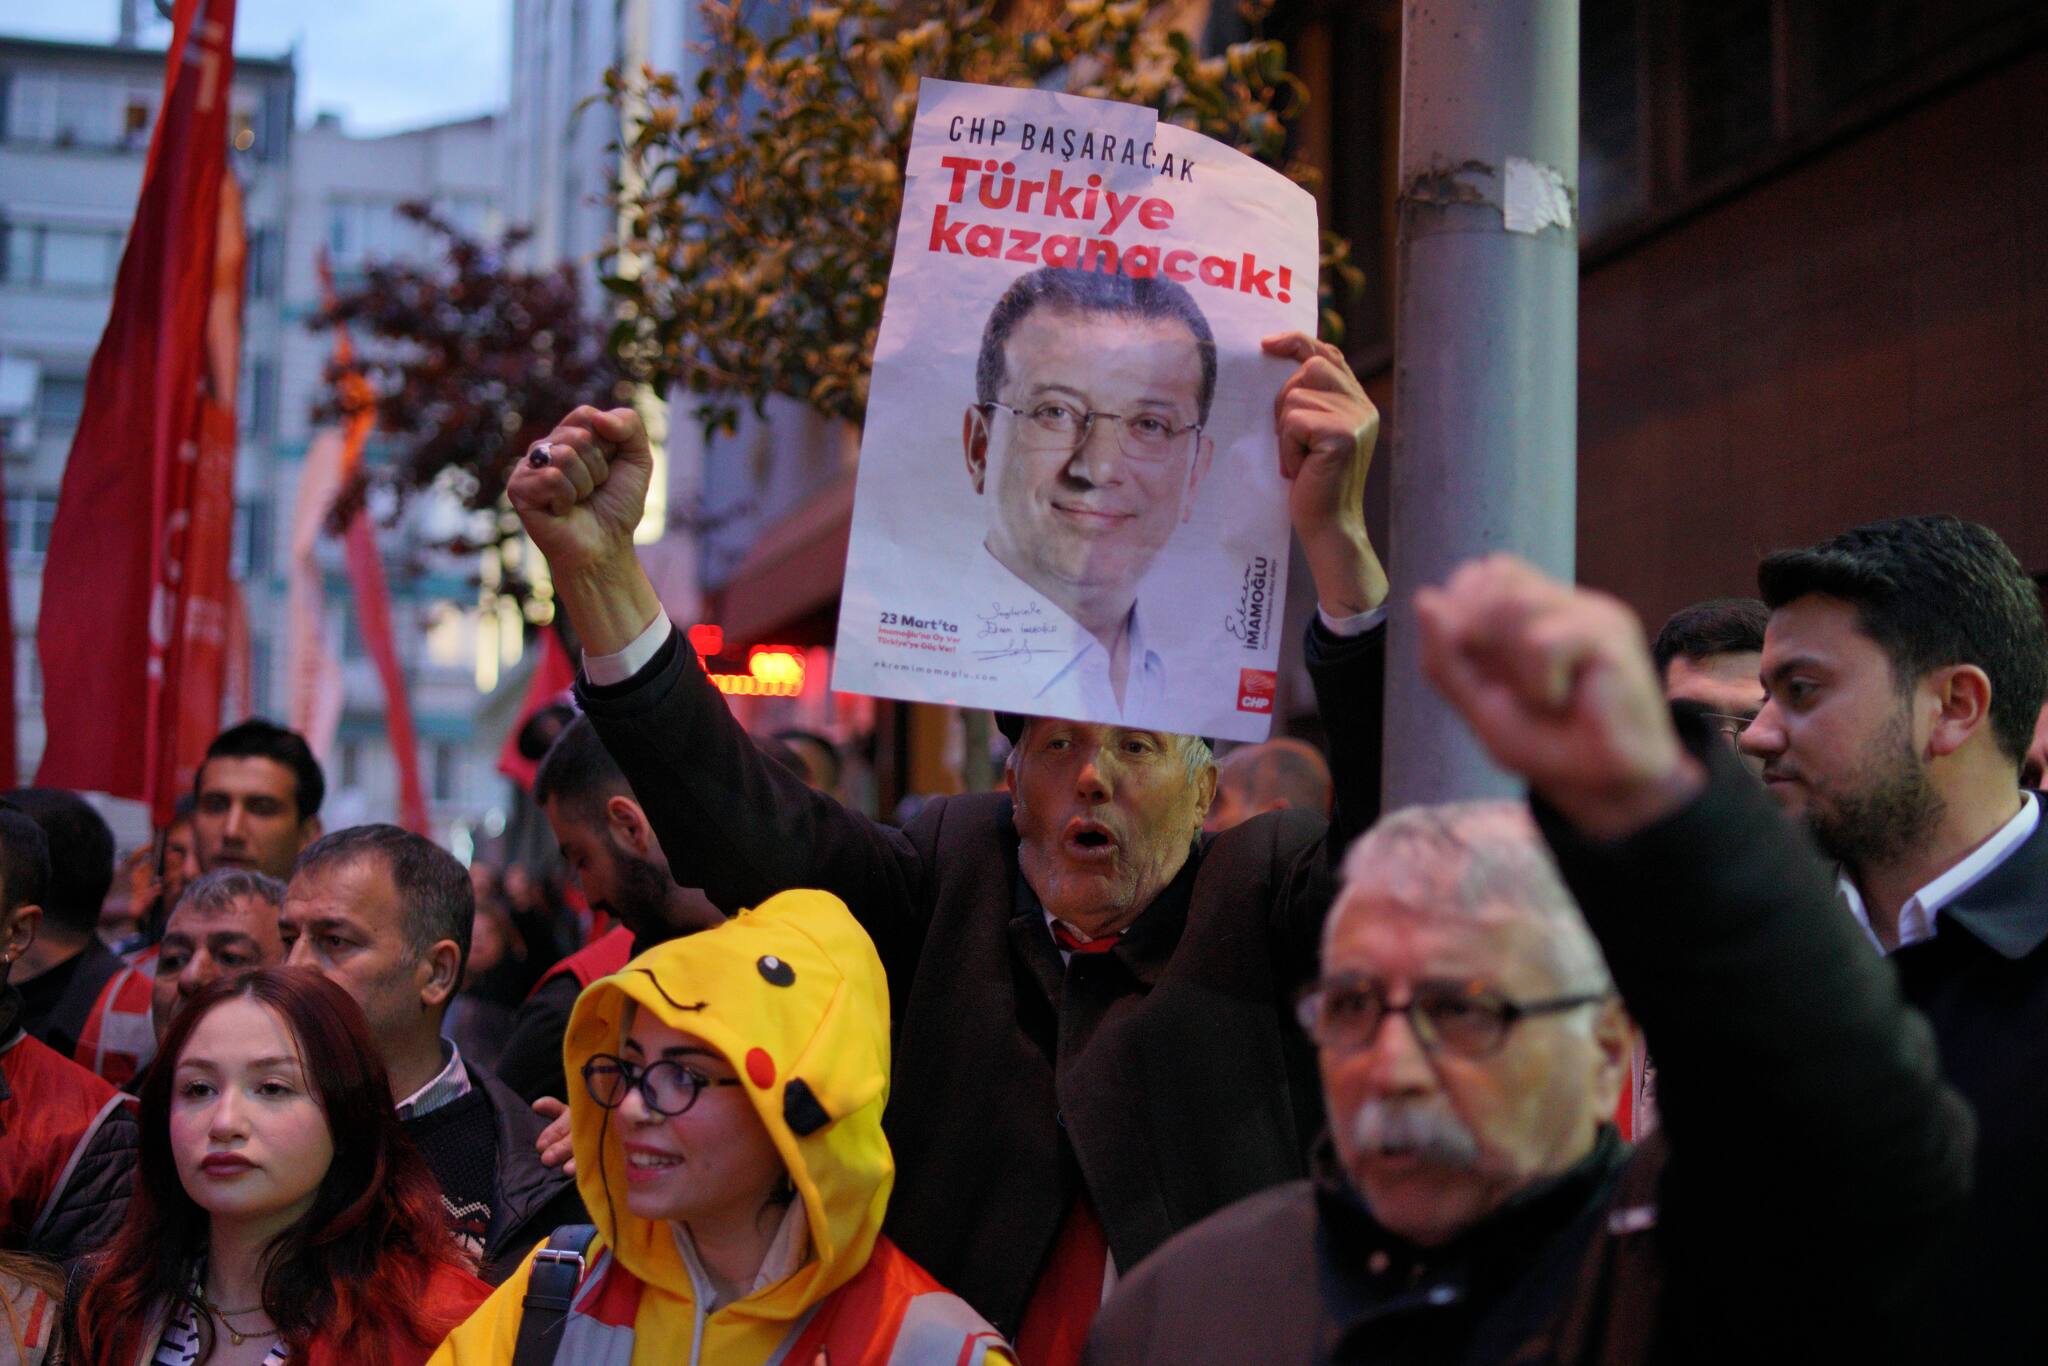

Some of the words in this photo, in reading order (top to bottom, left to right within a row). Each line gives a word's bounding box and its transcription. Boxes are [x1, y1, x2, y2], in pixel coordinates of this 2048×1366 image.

[949, 116, 1007, 147] CHP
[1020, 122, 1196, 183] BAŞARACAK
[941, 156, 1176, 235] Türkiye
[928, 204, 1294, 305] kazanacak!
[880, 611, 898, 625] 23
[900, 614, 959, 633] Mart'ta
[1243, 556, 1268, 650] İMAMOĞLU
[1241, 695, 1271, 710] CHP
